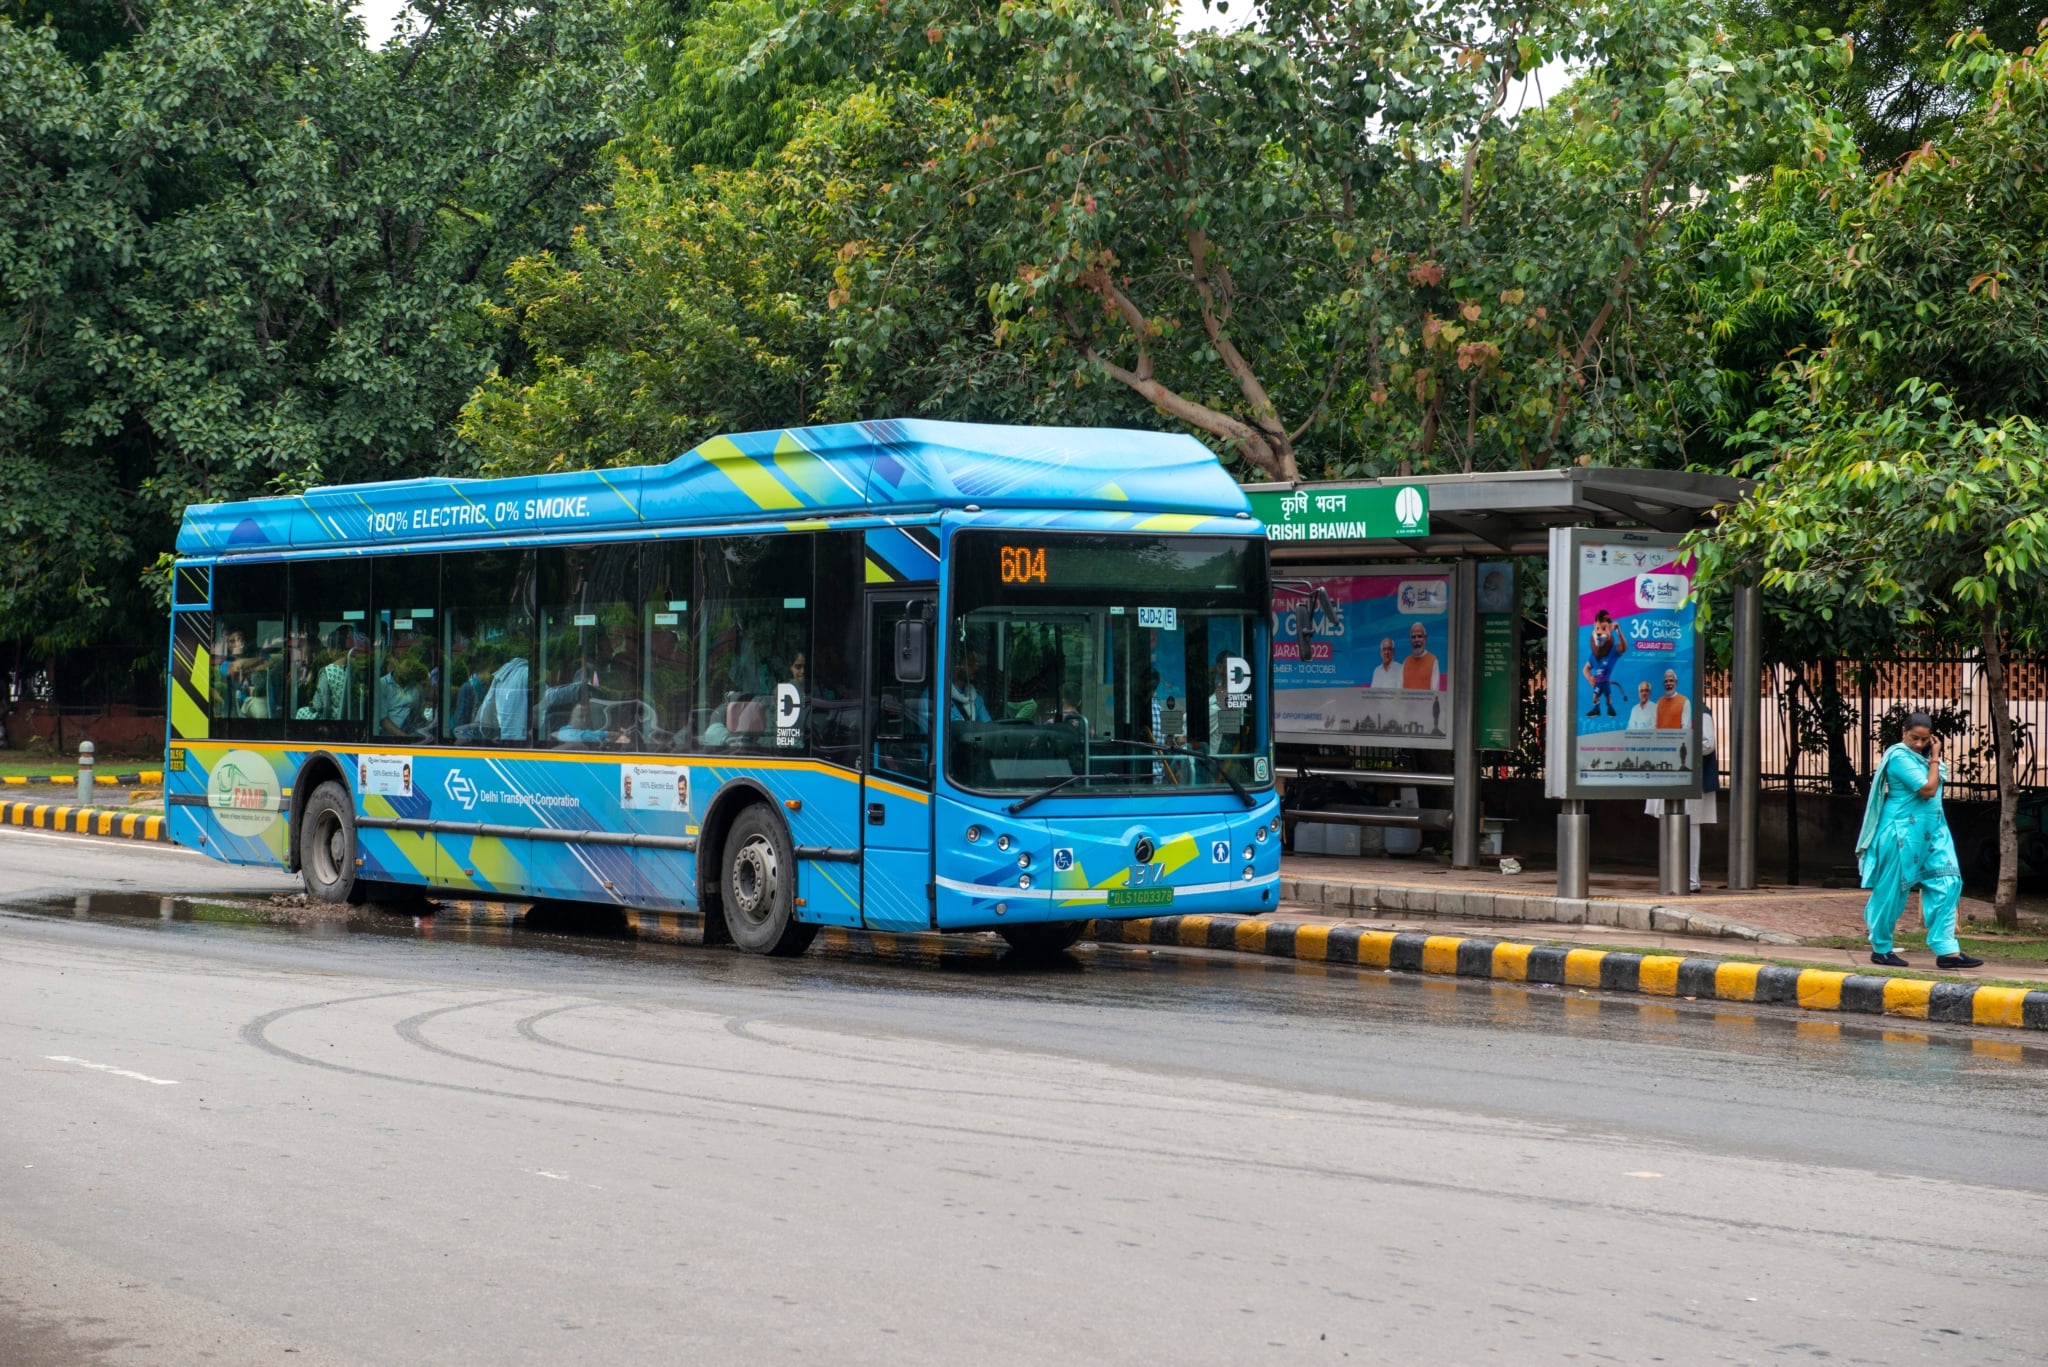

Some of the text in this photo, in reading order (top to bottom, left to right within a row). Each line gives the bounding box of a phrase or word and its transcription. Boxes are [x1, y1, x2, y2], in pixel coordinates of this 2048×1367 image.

[1280, 490, 1347, 521] कृषि भवन
[366, 511, 408, 533] 100%
[495, 501, 520, 522] 0%
[524, 496, 591, 520] SMOKE.
[1265, 521, 1367, 541] KRISHI BHAWAN
[1000, 545, 1048, 584] 604
[1140, 608, 1162, 624] RJD-2
[1652, 627, 1682, 639] GAMES
[1306, 664, 1337, 674] OCTOBER
[1227, 693, 1252, 702] SWITCH
[1227, 701, 1248, 709] DELHI
[777, 728, 800, 737] SWITCH
[776, 737, 795, 746] DELHI
[233, 787, 265, 809] FAME
[480, 789, 580, 809] Delhi Transport Corporation
